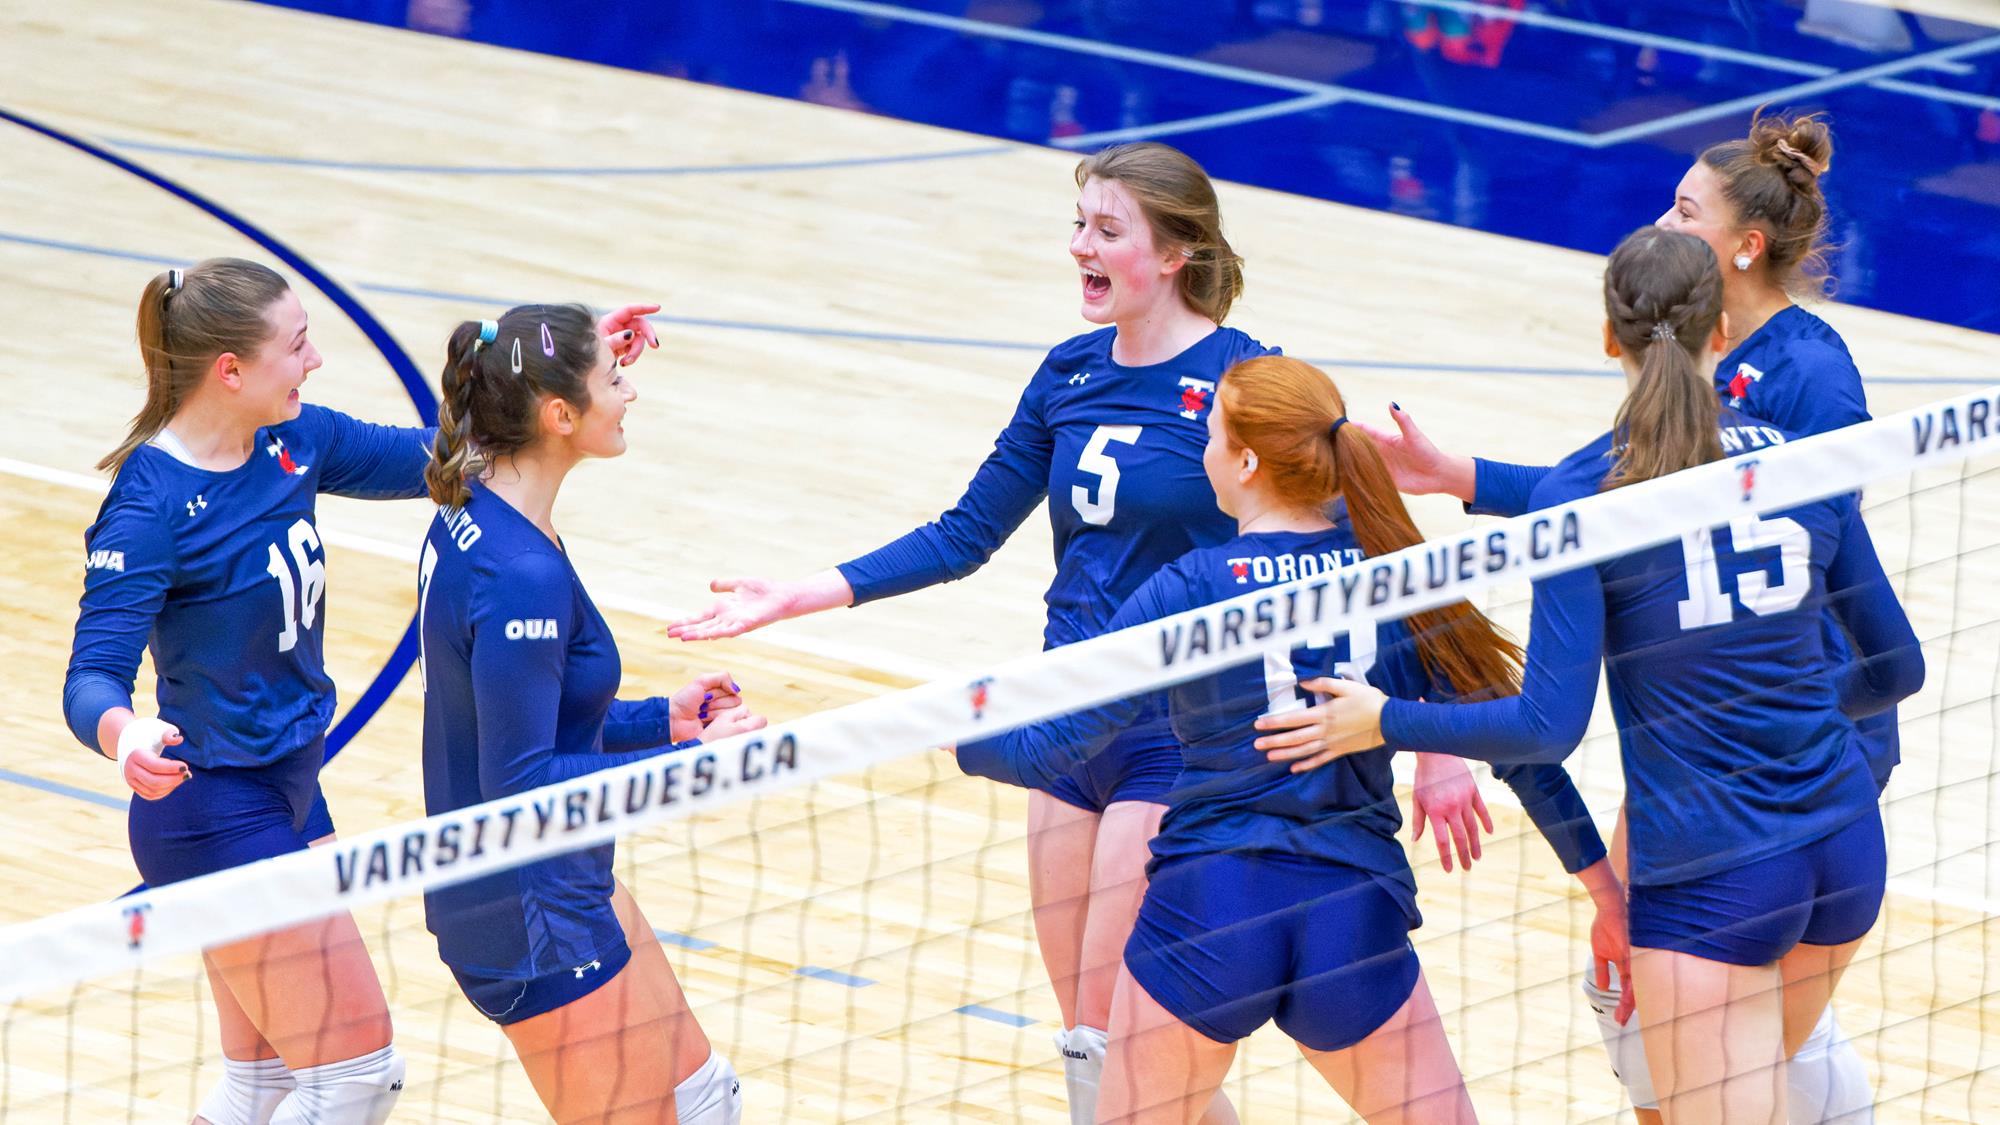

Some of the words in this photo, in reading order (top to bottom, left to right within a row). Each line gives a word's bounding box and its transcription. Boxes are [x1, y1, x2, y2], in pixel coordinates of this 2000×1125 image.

[1071, 425, 1143, 526] 5
[1912, 393, 2000, 456] VAR
[266, 518, 325, 653] 16
[504, 618, 559, 640] OUA
[1161, 511, 1581, 666] VARSITYBLUES.CA
[1678, 514, 1812, 631] 15
[335, 733, 799, 893] VARSITYBLUES.CA
